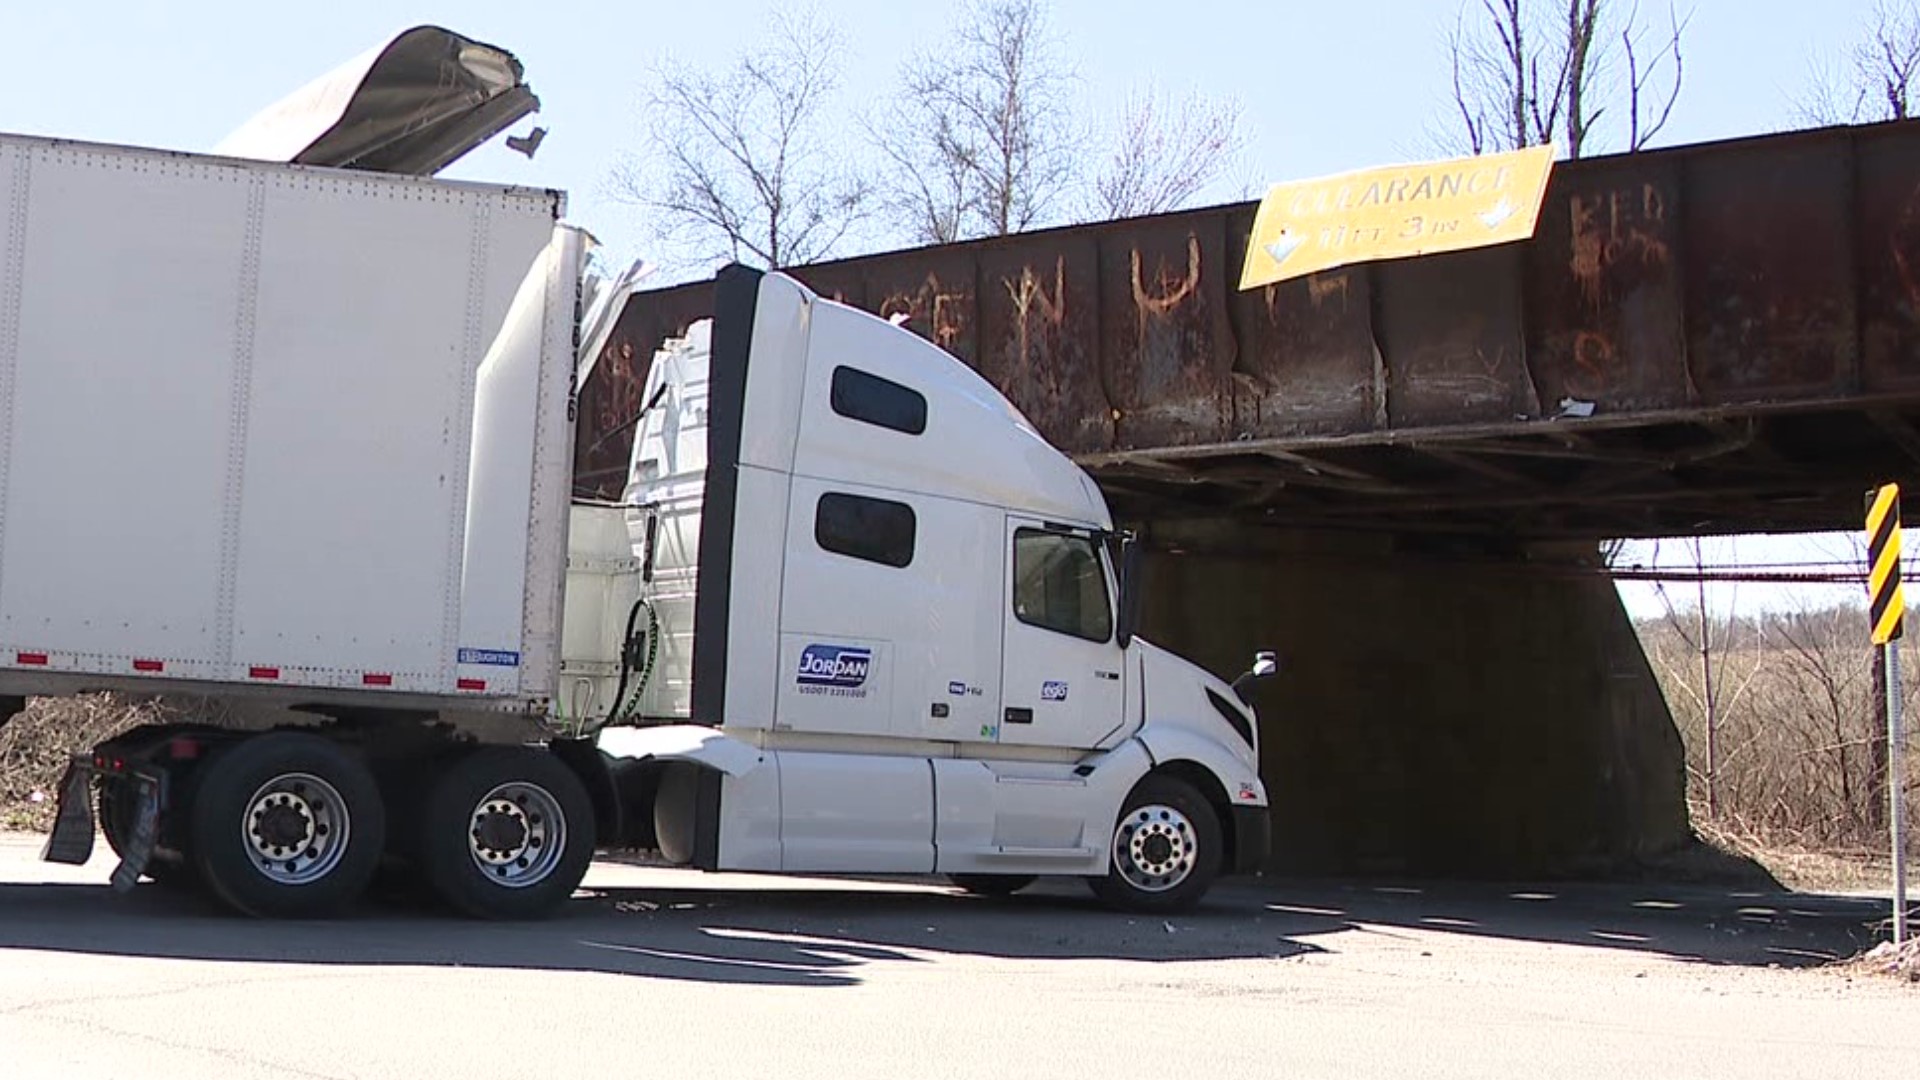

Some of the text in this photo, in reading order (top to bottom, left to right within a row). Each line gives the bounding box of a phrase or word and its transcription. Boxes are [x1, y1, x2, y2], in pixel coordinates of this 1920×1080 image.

[1290, 166, 1513, 215] CLEARANCE
[1399, 214, 1424, 239] 3
[800, 651, 868, 678] JORDAN
